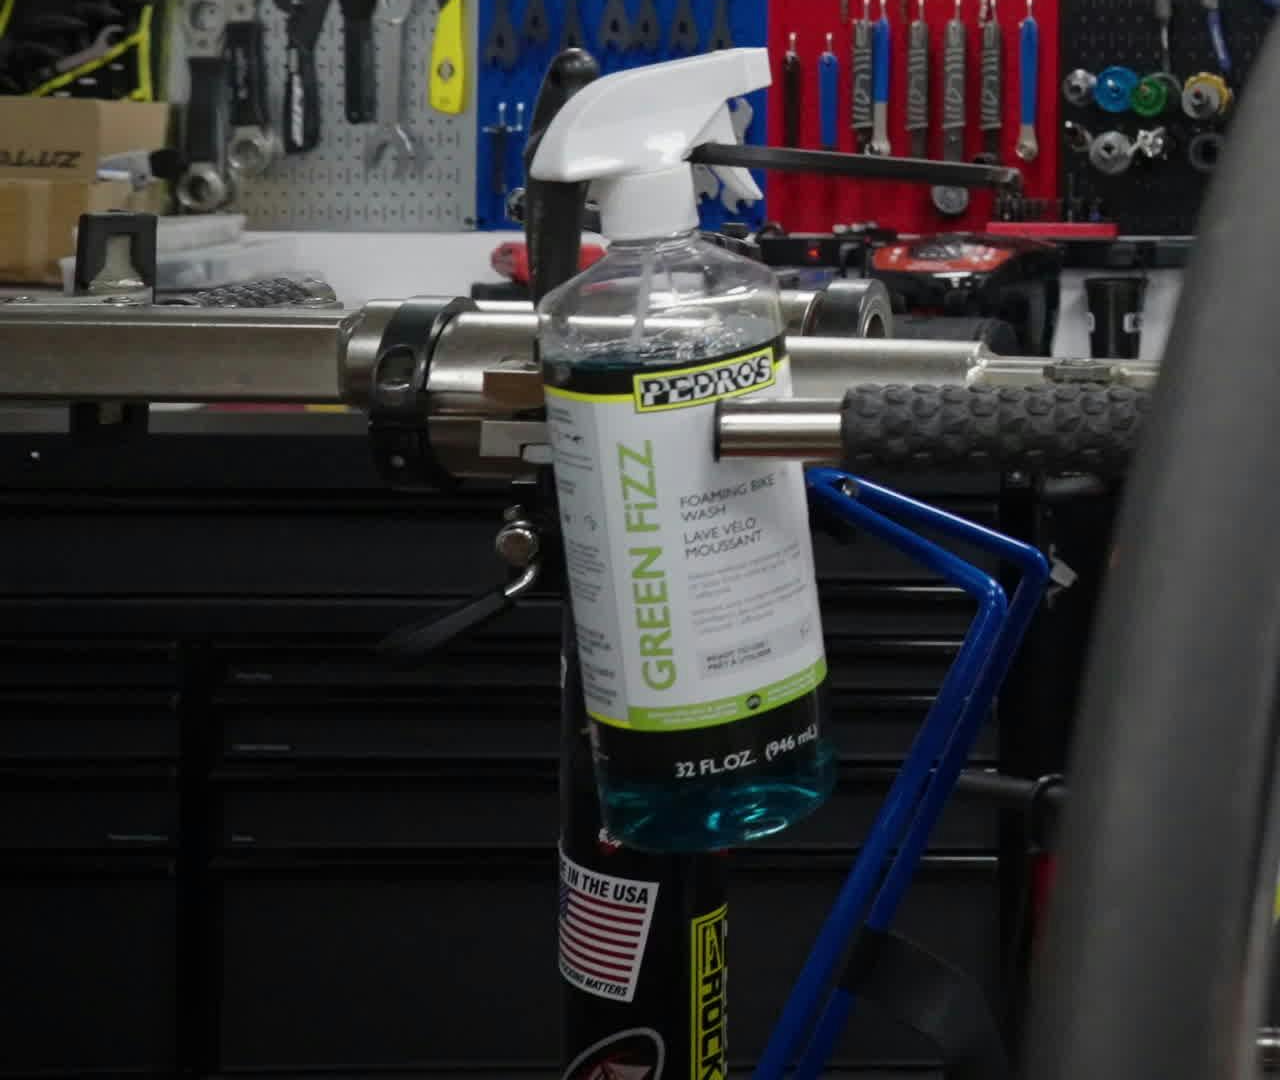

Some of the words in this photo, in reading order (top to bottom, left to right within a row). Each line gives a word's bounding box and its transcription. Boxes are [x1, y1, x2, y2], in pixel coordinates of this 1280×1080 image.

[680, 483, 748, 509] FOAMING
[750, 473, 776, 494] BIKE
[681, 505, 727, 522] WASH
[684, 525, 723, 545] LAVE
[685, 529, 763, 560] MOUSSANT
[629, 546, 678, 692] GREEN
[675, 761, 697, 779] 32
[567, 866, 579, 887] IN
[582, 874, 610, 898] THE
[613, 883, 649, 905] USA
[585, 977, 629, 997] MATTERS
